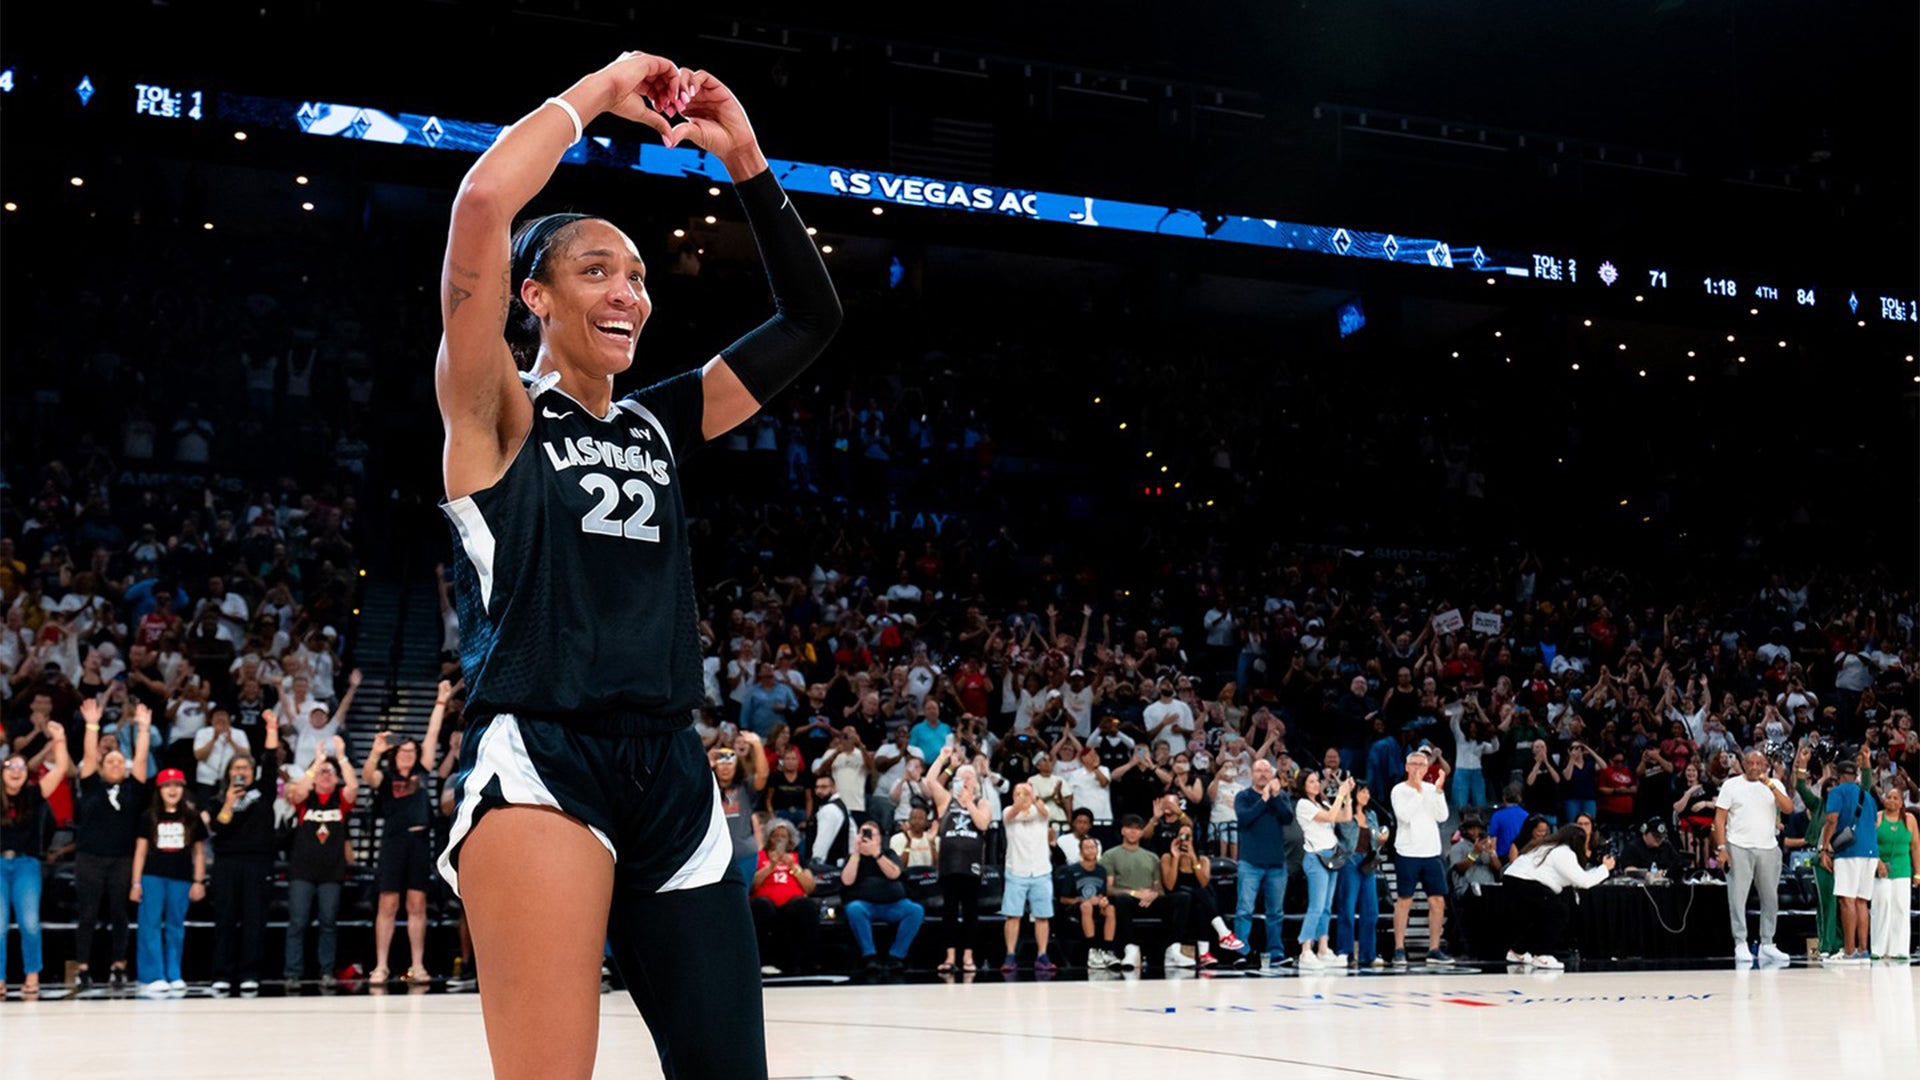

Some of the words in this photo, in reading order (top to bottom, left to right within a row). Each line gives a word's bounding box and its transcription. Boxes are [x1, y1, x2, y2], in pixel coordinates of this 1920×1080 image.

[0, 70, 15, 92] 4
[135, 83, 182, 104] TOL:
[191, 91, 202, 105] 1
[136, 100, 181, 118] FLS:
[188, 105, 202, 120] 4
[878, 176, 994, 209] VEGAS
[1532, 254, 1562, 269] TOL:
[1568, 259, 1576, 271] 2
[1534, 266, 1562, 280] FLS:
[1648, 270, 1667, 288] 71
[1703, 277, 1737, 296] 1:18
[1755, 286, 1778, 299] 4TH
[1796, 288, 1816, 306] 84
[1879, 296, 1906, 311] TOL:
[1881, 307, 1906, 321] FLS:
[579, 472, 660, 543] 22
[773, 872, 788, 884] 12
